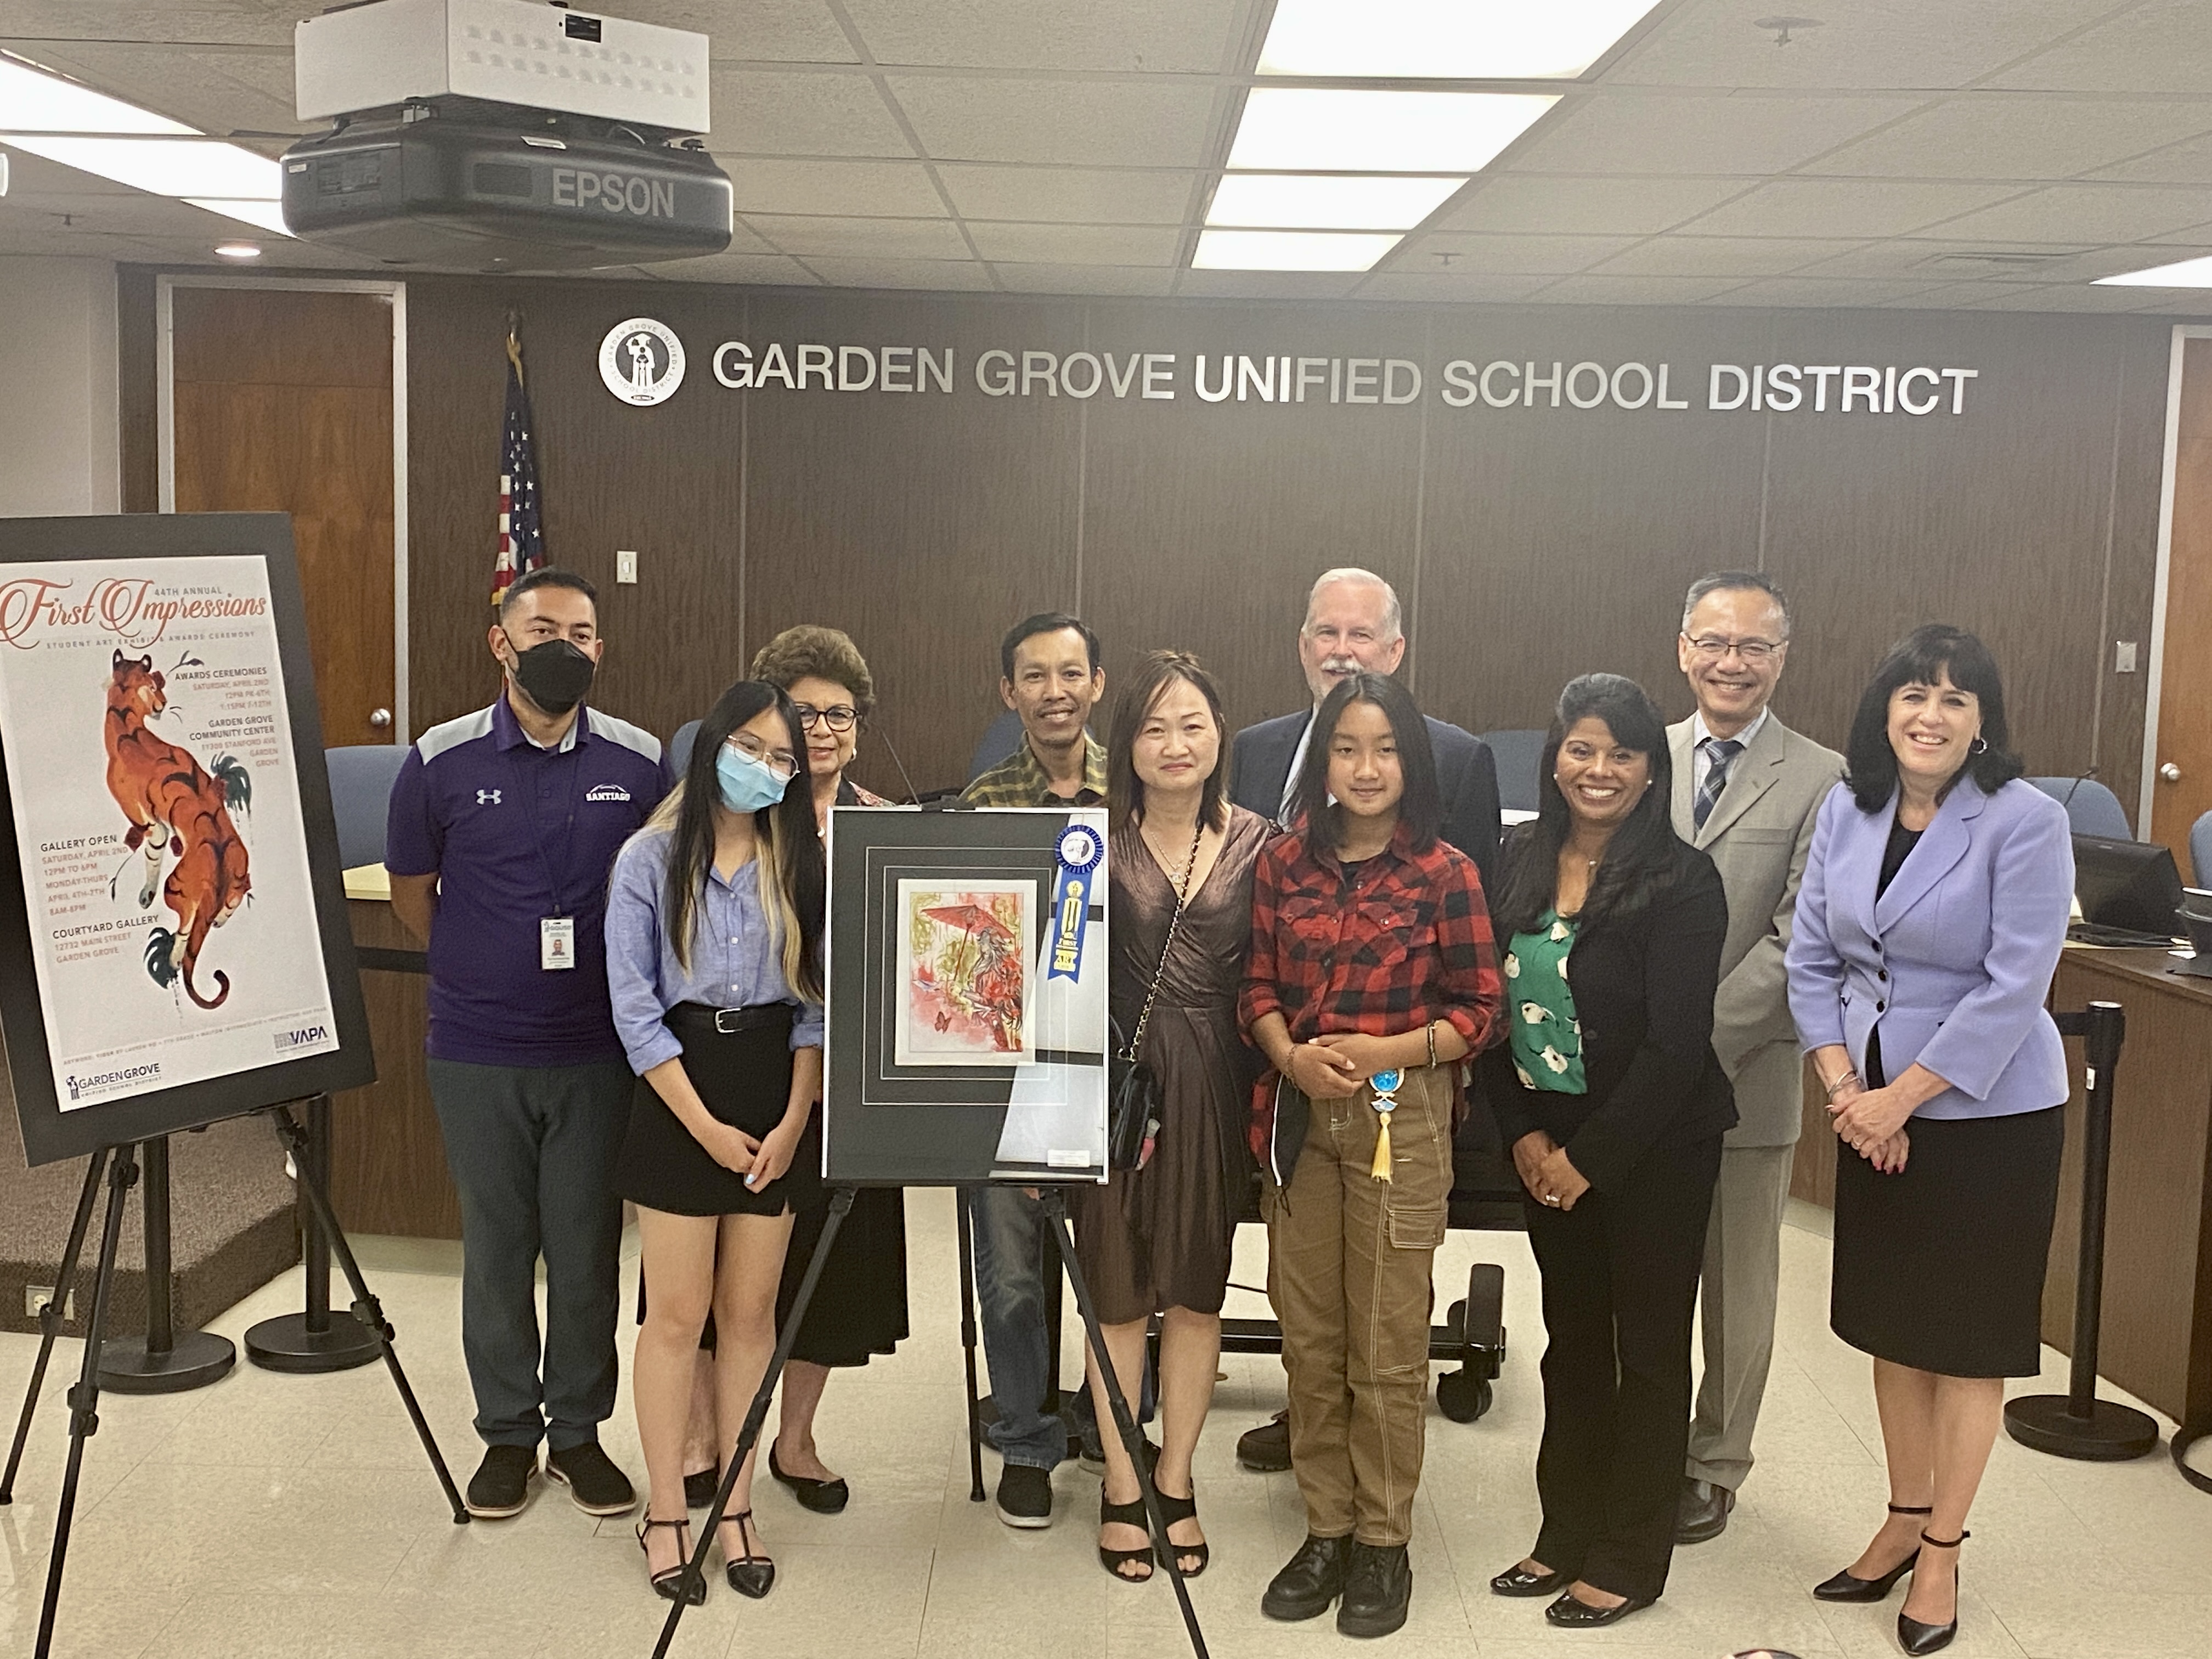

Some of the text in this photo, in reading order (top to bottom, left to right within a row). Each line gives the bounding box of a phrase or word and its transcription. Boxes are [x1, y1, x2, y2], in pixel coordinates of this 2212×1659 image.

[553, 168, 674, 218] EPSON
[607, 324, 677, 365] GARDEN GROVE UNIFIED
[643, 372, 674, 393] DISTRICT
[713, 341, 1979, 415] GARDEN GROVE UNIFIED SCHOOL DISTRICT
[154, 586, 222, 596] 44TH ANNUAL
[0, 578, 267, 650] First Impressions
[47, 640, 91, 649] STUDENT
[96, 638, 112, 646] ART
[168, 634, 204, 642] AWARDS
[209, 631, 255, 640] CEREMONY
[175, 667, 267, 681] AWARDS CEREMONIES
[208, 715, 273, 727] GARDEN GROVE
[189, 725, 274, 741] COMMUNITY CENTER
[250, 748, 278, 757] GARDEN
[256, 759, 279, 767] GROVE
[586, 792, 630, 802] SANTIAGO
[40, 834, 117, 852] GALLERY OPEN
[42, 847, 128, 865] SATURDAY, APRIL 2ND
[44, 866, 65, 876] 12PM
[68, 865, 79, 873] TO
[48, 892, 69, 902] APRIL
[53, 915, 159, 939] COURTYARD GALLERY
[81, 938, 102, 947] MAIN
[104, 932, 132, 944] STREET
[56, 947, 119, 963] GARDEN GROVE
[290, 1025, 328, 1044] VAPA
